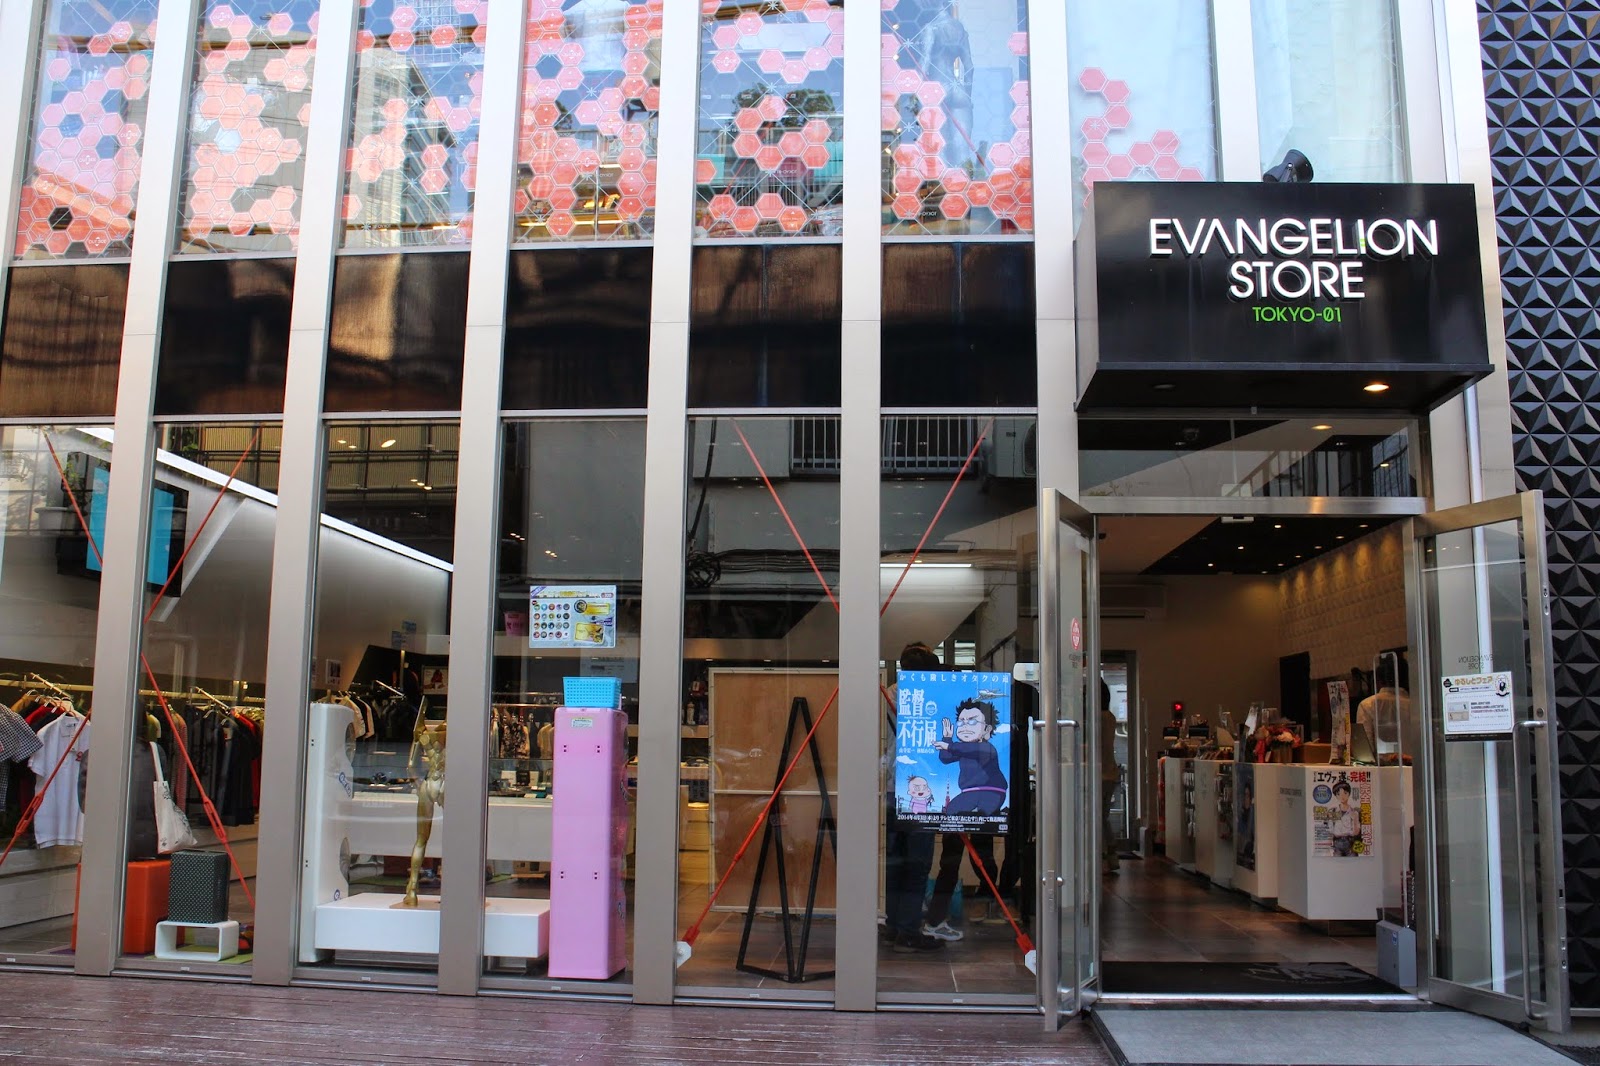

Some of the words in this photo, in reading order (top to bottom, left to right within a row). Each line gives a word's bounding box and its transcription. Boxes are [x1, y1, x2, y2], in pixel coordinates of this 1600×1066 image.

[1149, 217, 1439, 256] EVANGELION
[1229, 260, 1366, 299] STORE
[1252, 306, 1342, 323] TOKYO-01
[898, 689, 925, 716] 監督
[897, 720, 937, 747] 不行届
